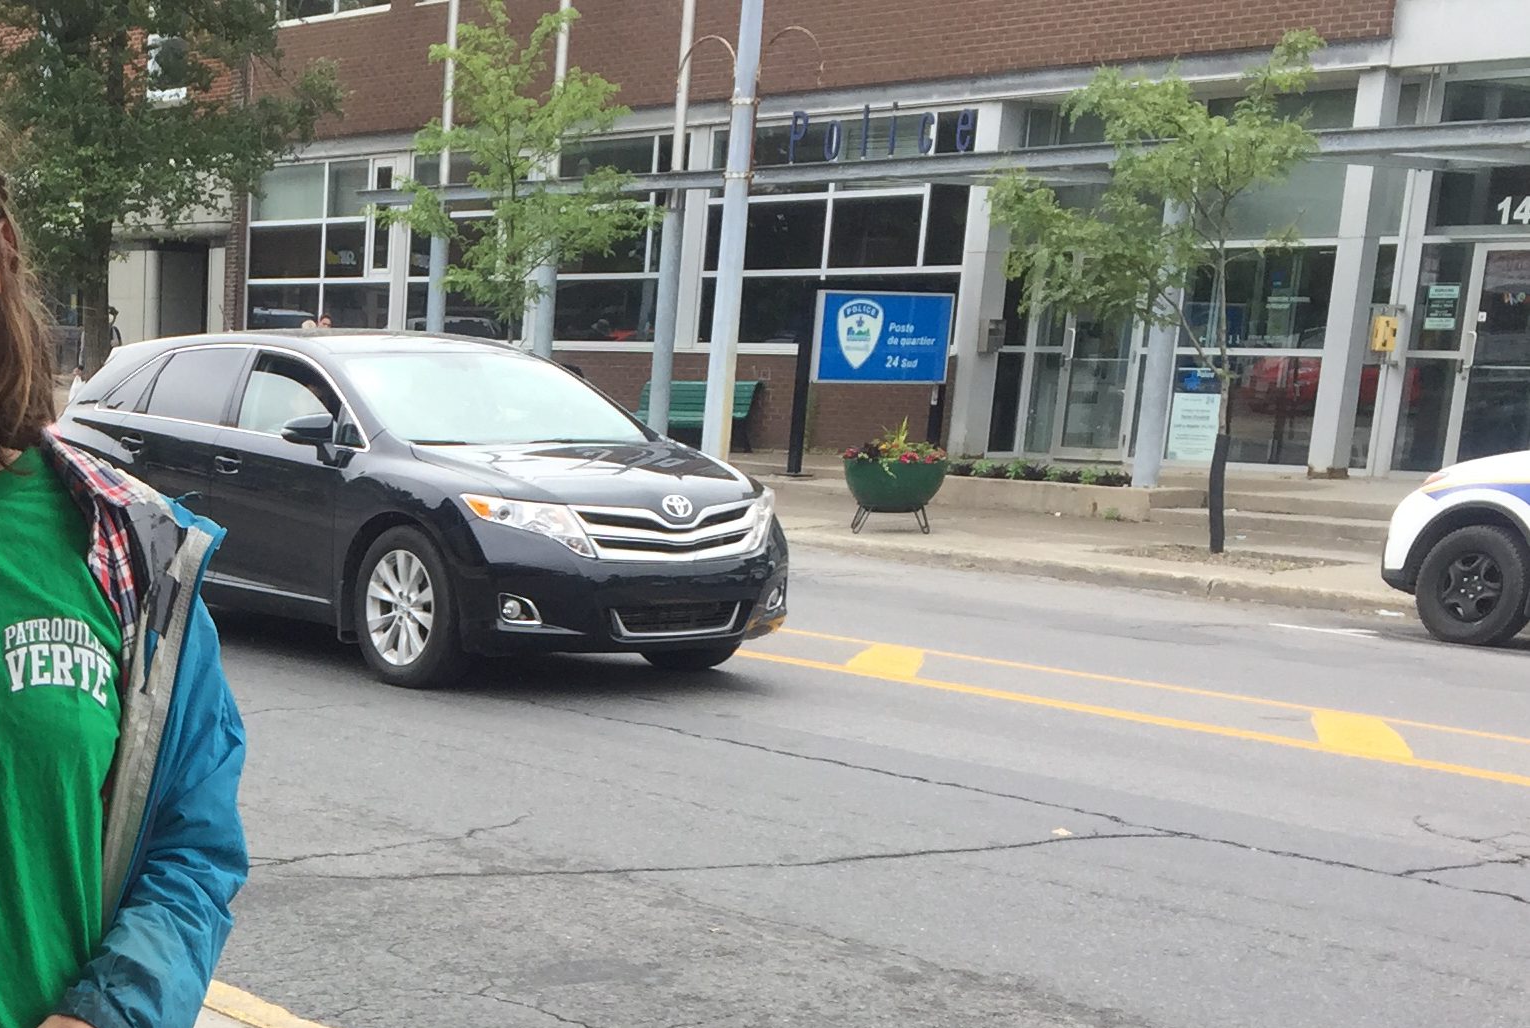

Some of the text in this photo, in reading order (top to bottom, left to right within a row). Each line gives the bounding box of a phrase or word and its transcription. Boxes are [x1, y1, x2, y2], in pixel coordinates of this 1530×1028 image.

[789, 102, 974, 165] Police
[845, 303, 877, 316] POLICE
[888, 322, 915, 334] Poste
[887, 335, 936, 347] de quartier
[885, 355, 919, 368] 24 Sud
[5, 644, 111, 707] VERTE
